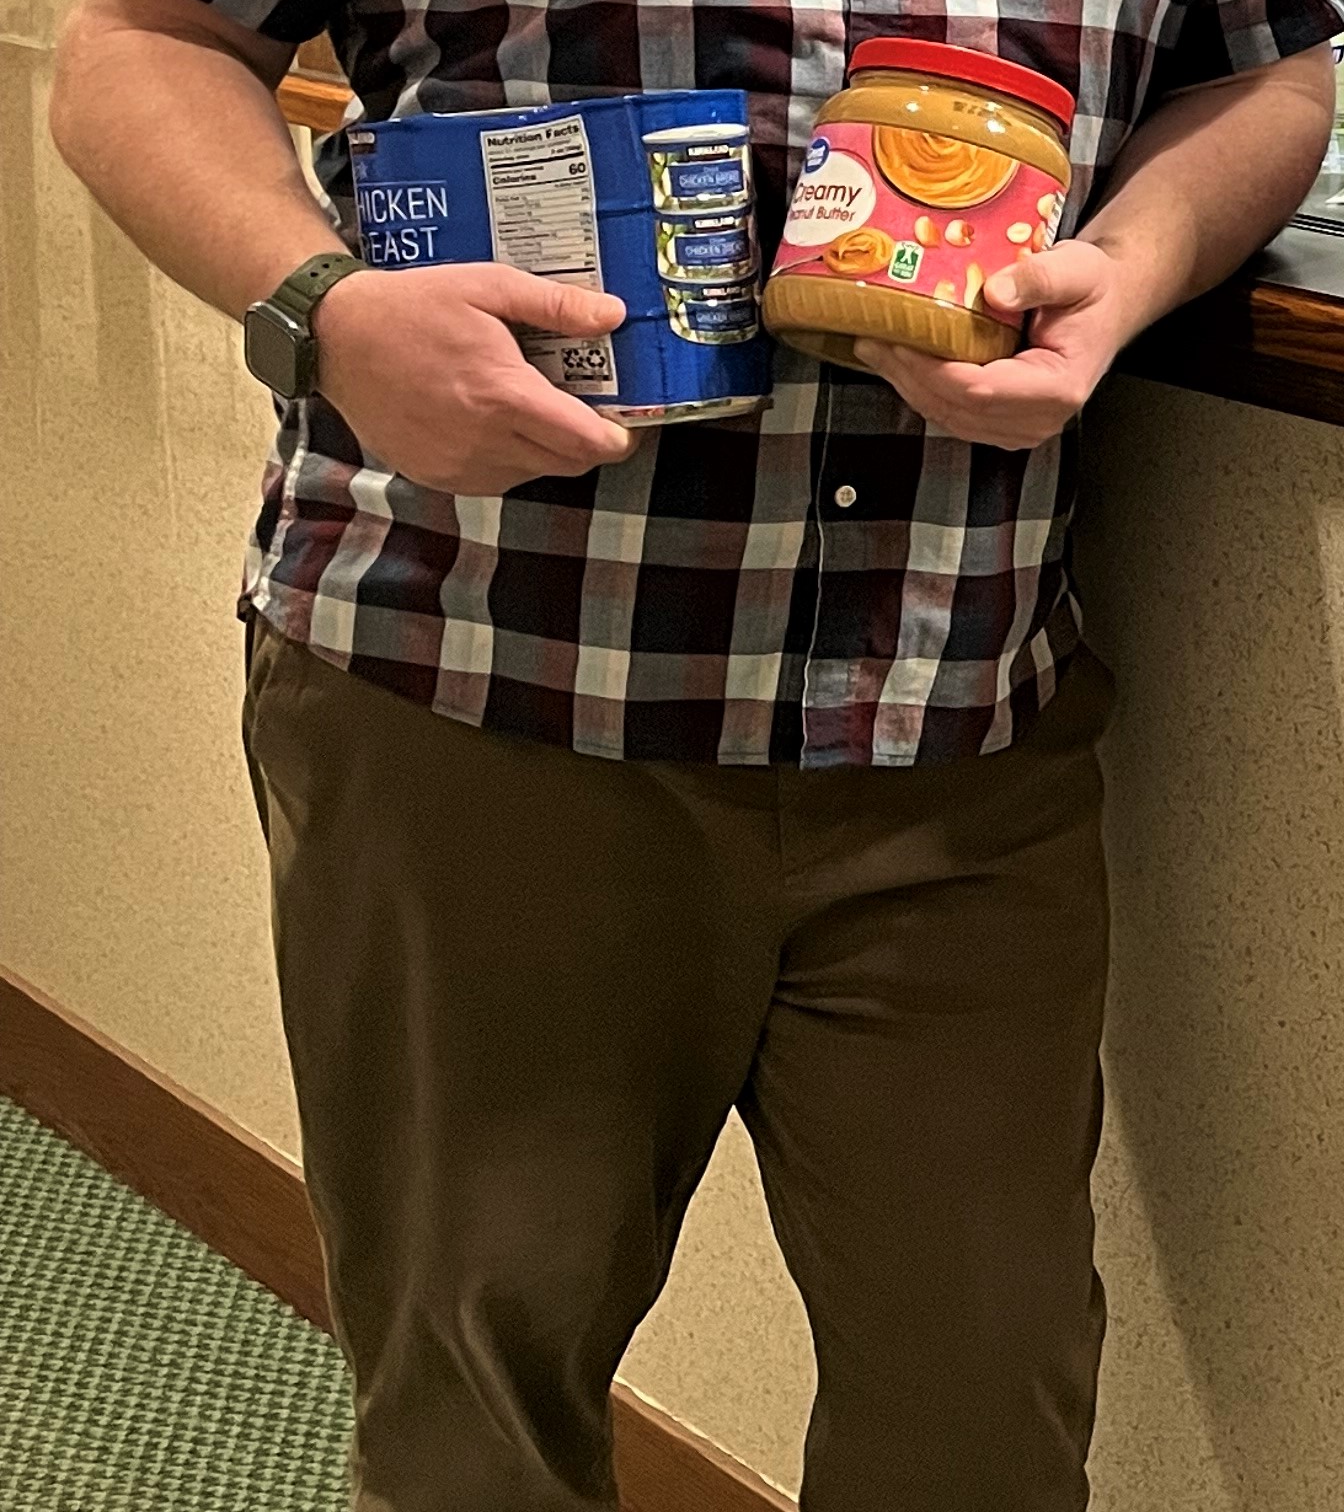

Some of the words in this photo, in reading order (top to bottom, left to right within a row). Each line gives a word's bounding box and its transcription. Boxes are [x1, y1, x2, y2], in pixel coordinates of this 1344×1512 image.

[487, 131, 543, 148] Nutrition
[545, 123, 580, 140] Facts
[492, 173, 537, 186] Calories
[568, 163, 587, 176] 60
[358, 186, 449, 224] HICKEN
[793, 182, 863, 208] Creamy
[816, 206, 856, 222] Butter
[368, 226, 439, 264] EAST
